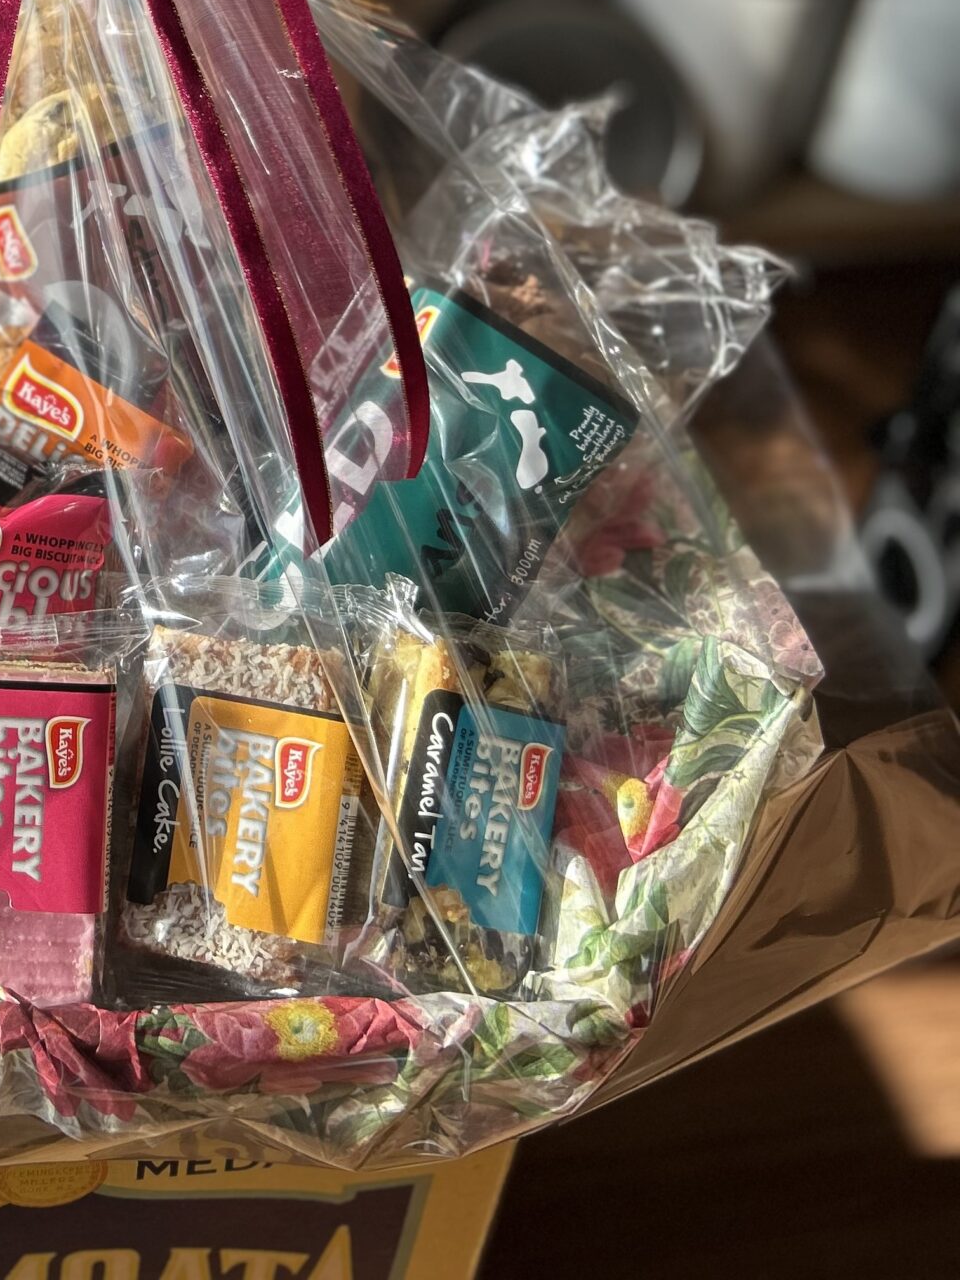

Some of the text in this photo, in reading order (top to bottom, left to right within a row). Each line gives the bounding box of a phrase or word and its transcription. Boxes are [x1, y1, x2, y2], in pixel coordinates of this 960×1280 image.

[17, 381, 71, 426] Kaye's
[568, 405, 600, 440] Proudly
[83, 443, 104, 460] BIG
[90, 434, 98, 443] A
[576, 422, 600, 451] baked
[595, 413, 607, 423] in
[582, 418, 616, 464] Southland
[11, 545, 32, 557] BIG
[14, 533, 20, 542] A
[510, 538, 542, 586] 300gm
[194, 721, 202, 735] OF
[204, 722, 211, 731] A
[467, 729, 475, 737] A
[58, 727, 72, 777] Kaye's
[284, 747, 304, 797] Kaye's
[418, 712, 453, 817] Caramel
[11, 717, 46, 882] BAKERY
[152, 707, 186, 854] Lollie Cake.
[206, 729, 237, 837] bites
[459, 734, 492, 842] bites
[524, 753, 540, 800] Kaye's
[232, 733, 277, 898] BAKERY
[476, 738, 522, 896] BAKERY
[327, 801, 350, 928] 9 414109 001409
[136, 1158, 272, 1180] MED
